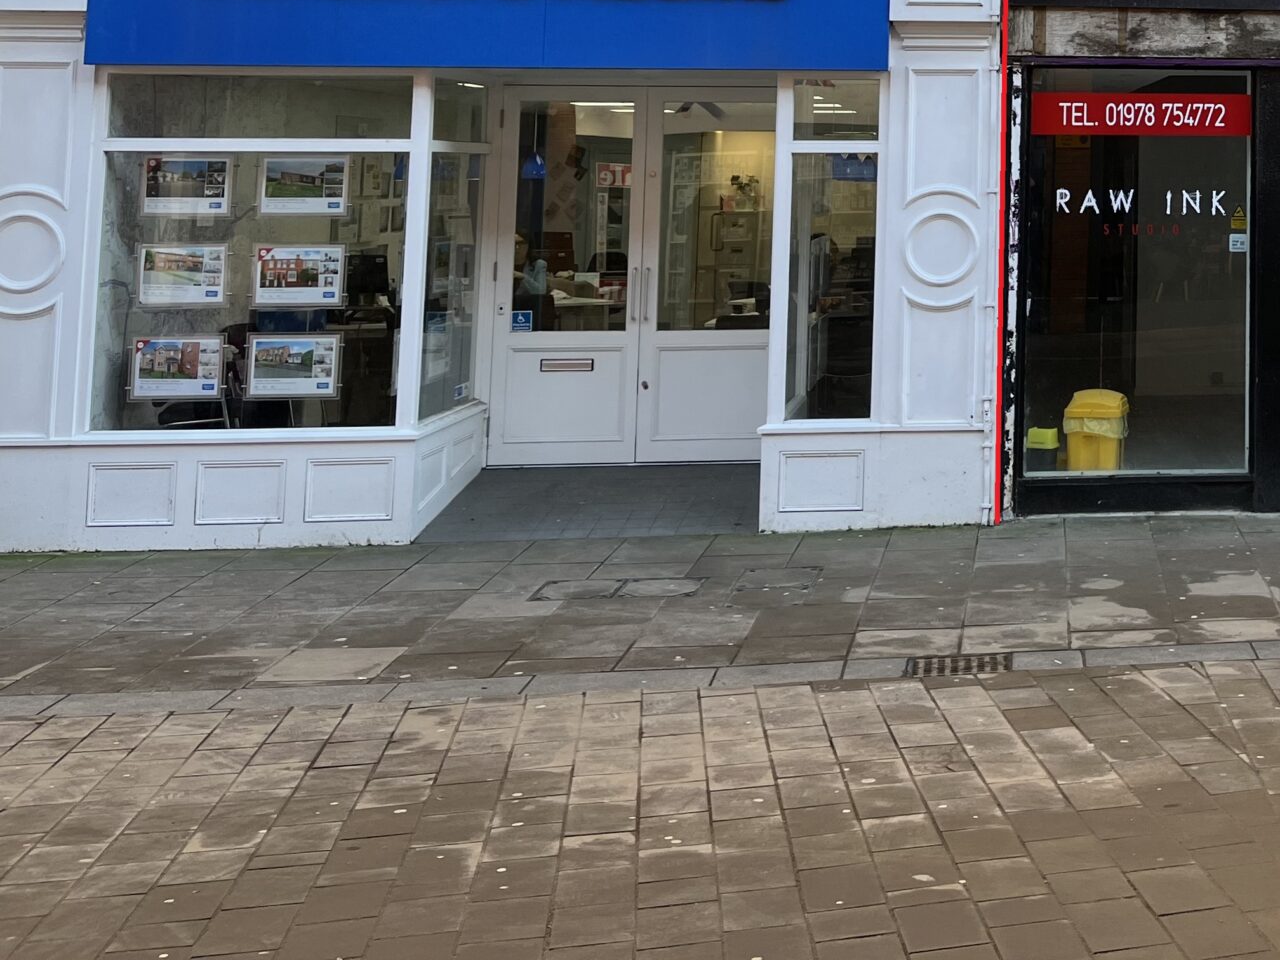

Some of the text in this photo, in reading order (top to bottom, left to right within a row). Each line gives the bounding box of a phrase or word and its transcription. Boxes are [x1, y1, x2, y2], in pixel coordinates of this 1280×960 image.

[1059, 102, 1226, 127] TEL. 01978 754772
[1056, 188, 1226, 216] RAW INK
[1103, 223, 1181, 236] STUDIO
